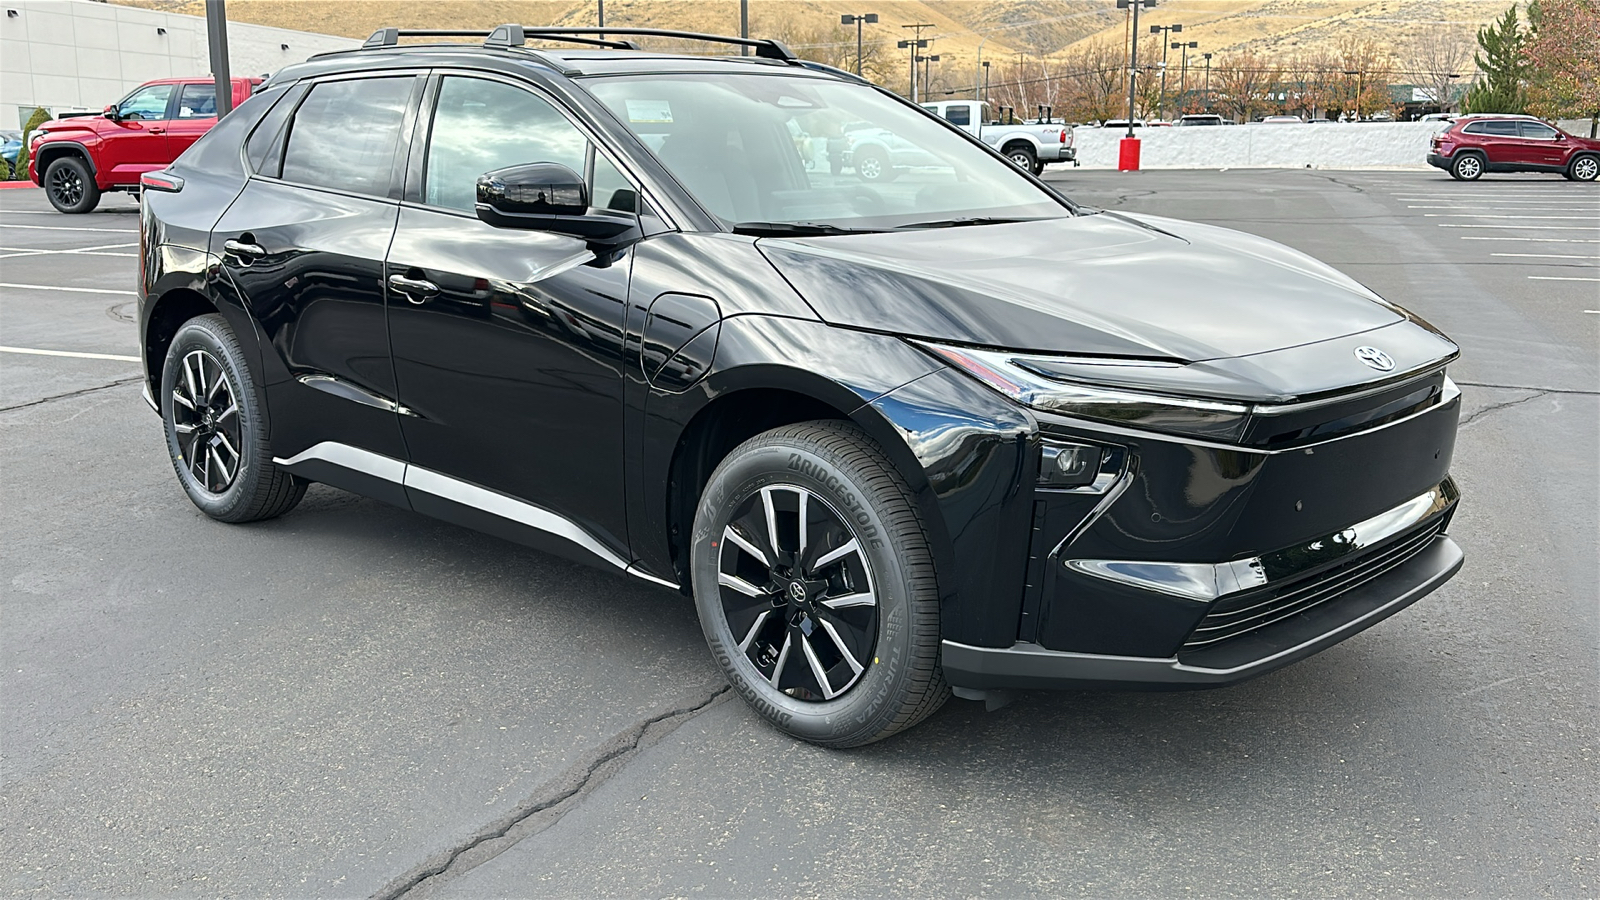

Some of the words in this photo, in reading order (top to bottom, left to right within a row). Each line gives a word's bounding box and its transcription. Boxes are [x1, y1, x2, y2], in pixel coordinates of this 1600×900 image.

[787, 452, 885, 551] BRIDGESTONE
[709, 632, 793, 729] BRIDGESTONE
[855, 646, 901, 724] TURANZA
